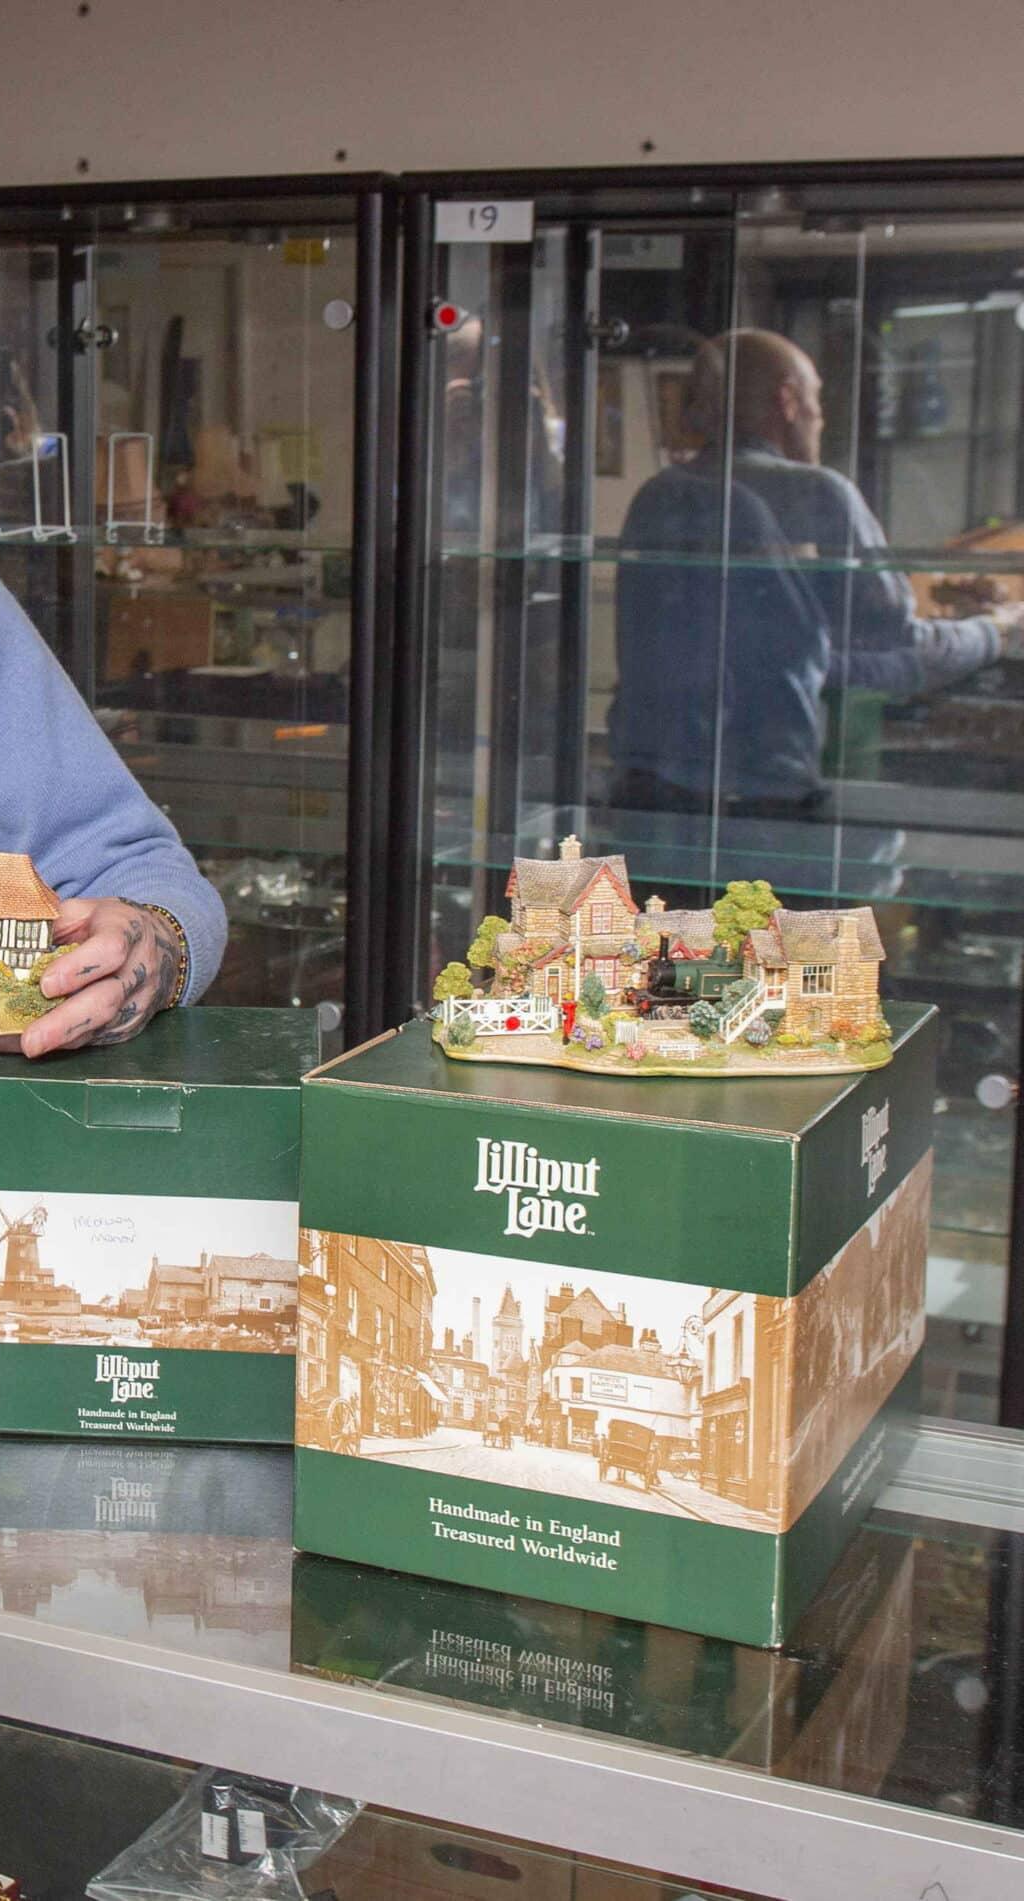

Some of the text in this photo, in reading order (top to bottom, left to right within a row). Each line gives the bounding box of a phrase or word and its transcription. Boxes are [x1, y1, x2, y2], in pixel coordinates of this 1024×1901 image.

[469, 205, 497, 232] 19
[473, 1137, 601, 1197] Lilliput
[503, 1187, 587, 1238] Lane
[95, 1354, 161, 1382] Lilliput
[110, 1378, 154, 1403] Lane
[78, 1407, 177, 1422] Handmade in England
[79, 1420, 176, 1433] Treasured Worldwide
[429, 1497, 621, 1547] Handmade in England
[432, 1521, 617, 1570] Treasured Worldwide
